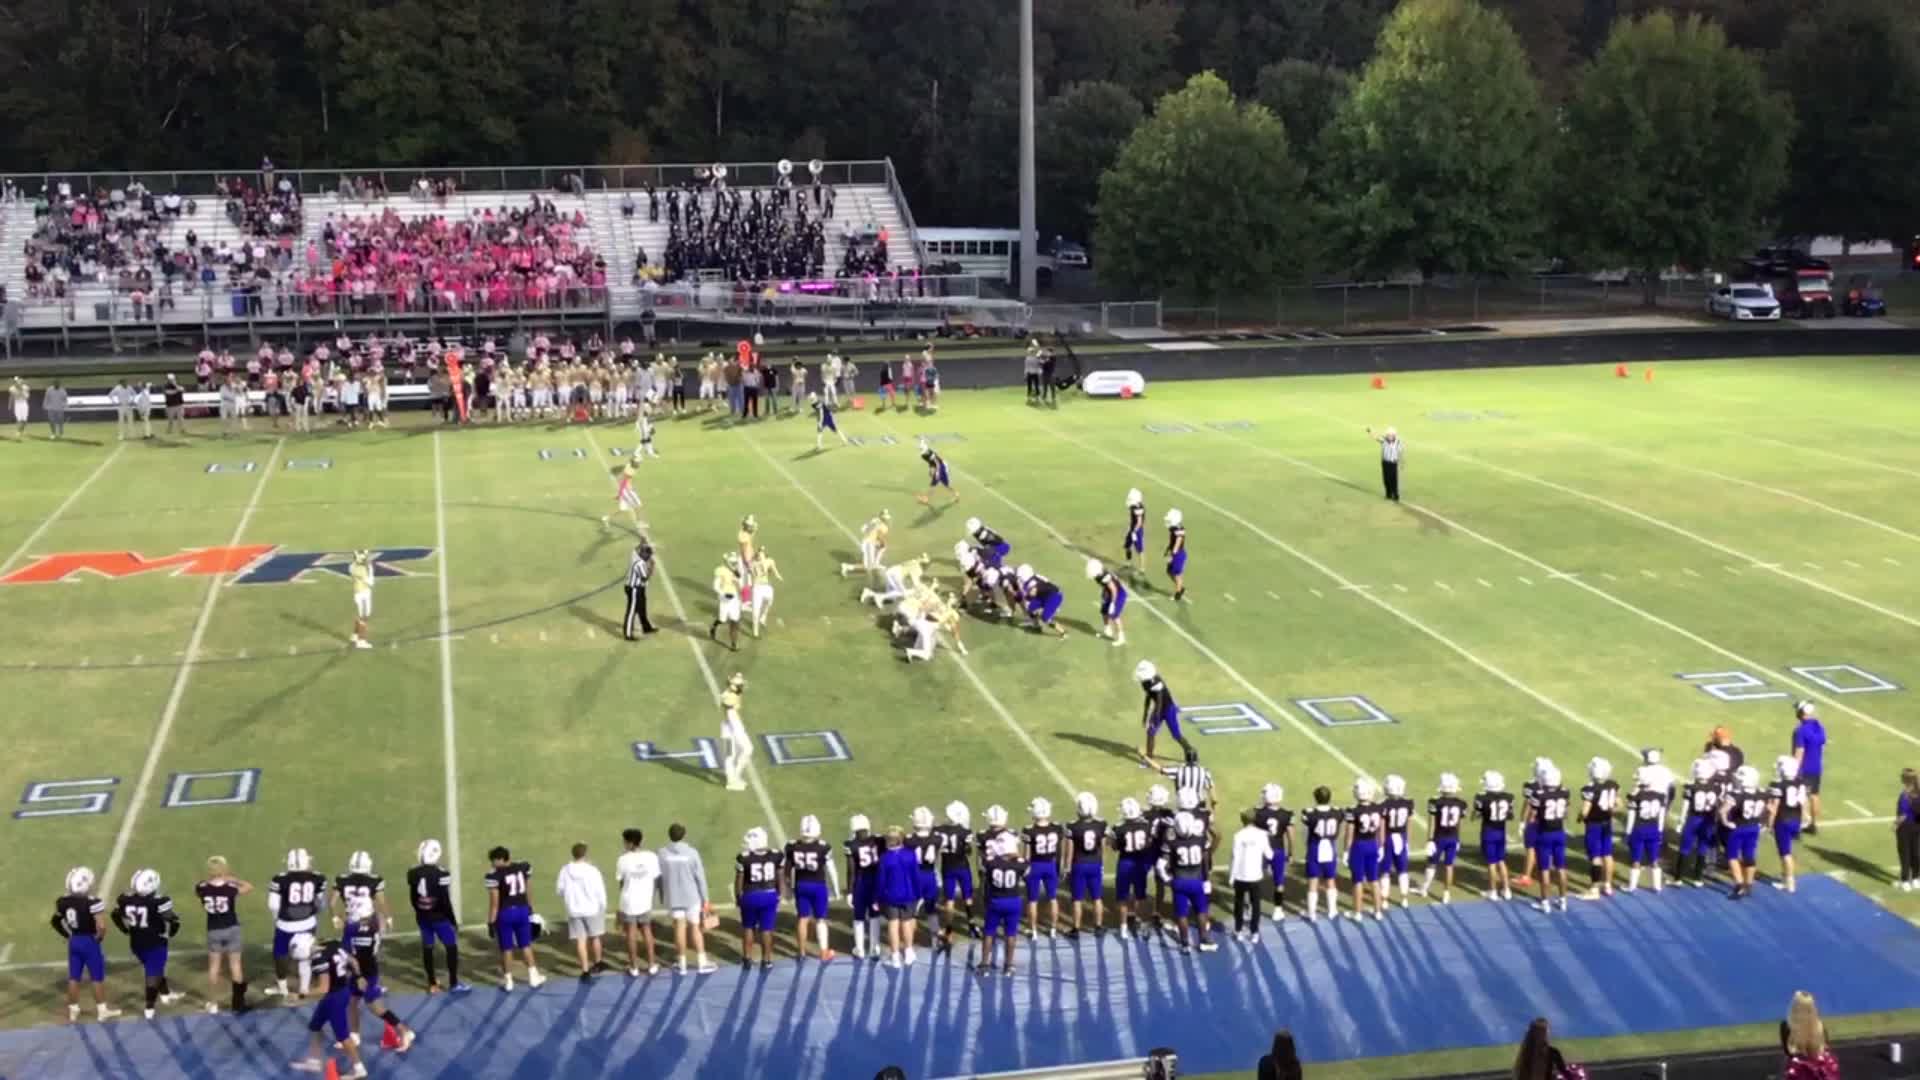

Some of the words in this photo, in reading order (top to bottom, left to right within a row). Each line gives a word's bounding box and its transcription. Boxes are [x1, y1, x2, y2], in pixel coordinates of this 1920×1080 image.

[0, 544, 438, 585] MR
[1035, 833, 1058, 854] 22
[794, 851, 818, 871] 55
[417, 878, 428, 897] 4
[504, 872, 526, 896] 71
[125, 905, 149, 929] 57
